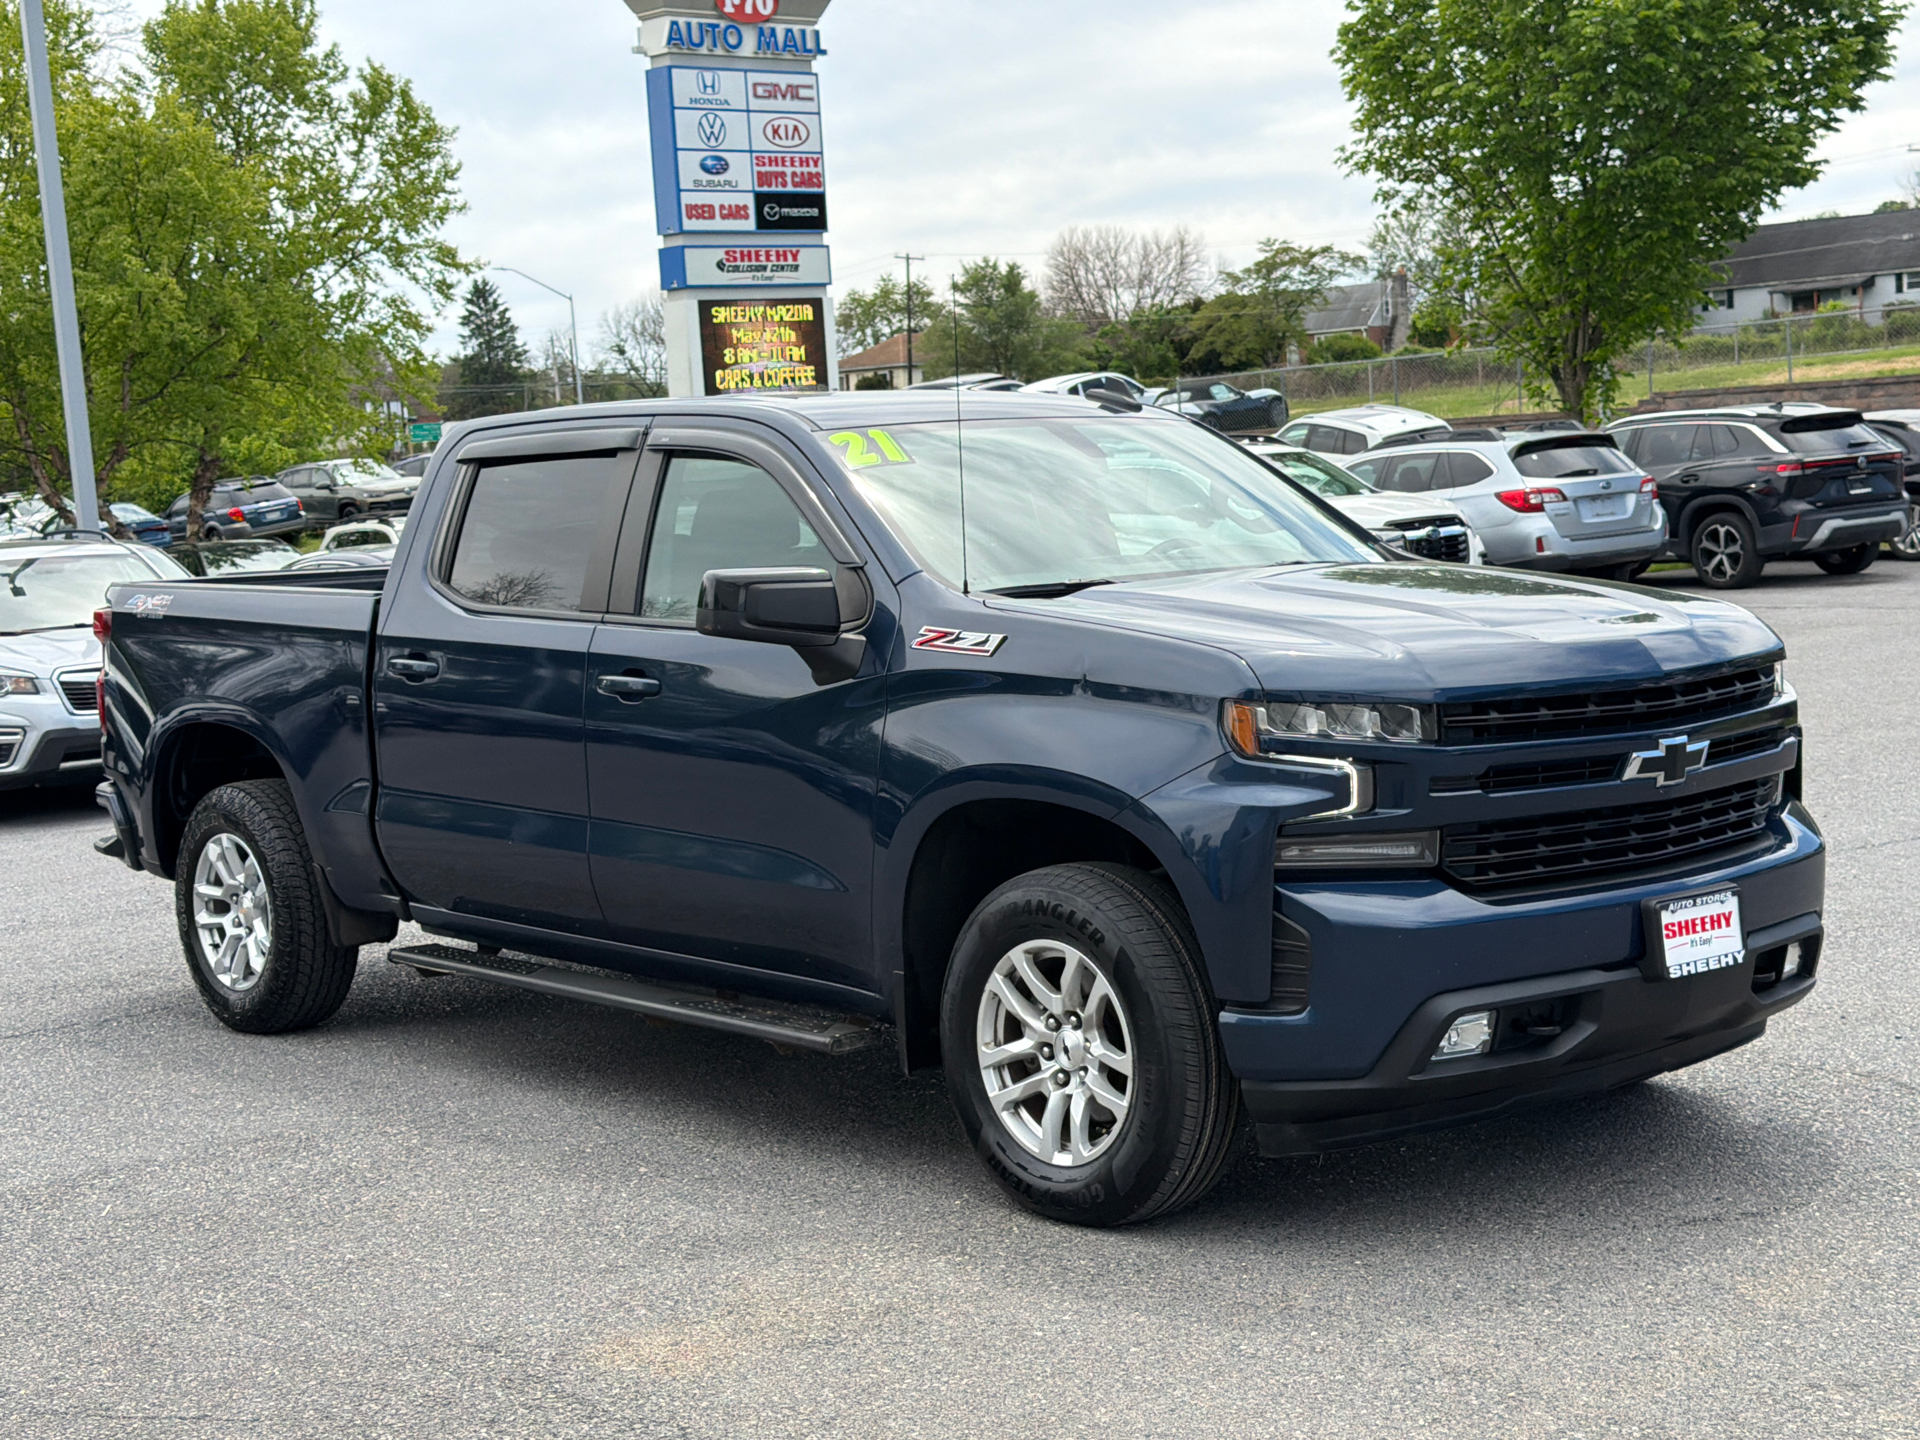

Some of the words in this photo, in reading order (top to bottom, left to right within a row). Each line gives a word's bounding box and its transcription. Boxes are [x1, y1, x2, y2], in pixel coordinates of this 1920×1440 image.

[667, 20, 743, 50] AUTO
[757, 27, 827, 55] MALL
[752, 82, 815, 102] GMC
[689, 97, 731, 106] HONDA
[771, 124, 803, 141] KIA
[755, 155, 820, 168] SHEEHY
[693, 179, 738, 188] SUBARU
[756, 170, 788, 188] BUYS
[791, 171, 823, 189] CARS
[685, 203, 716, 220] USED
[719, 203, 750, 221] CARS
[724, 249, 801, 263] SHEEHY
[726, 264, 768, 273] COLLISION
[770, 264, 800, 272] CENTER
[711, 305, 764, 323] SHEEHY
[731, 327, 761, 345] May
[723, 348, 736, 364] 8
[715, 369, 751, 390] CARS
[752, 373, 762, 388] &
[764, 366, 817, 388] COFFEE
[828, 429, 909, 468] 21
[910, 625, 1008, 657] Z71
[1668, 901, 1693, 912] AUTO
[1696, 891, 1732, 906] STORES
[1664, 911, 1733, 940] SHEEHY
[1669, 949, 1746, 979] SHEEHY
